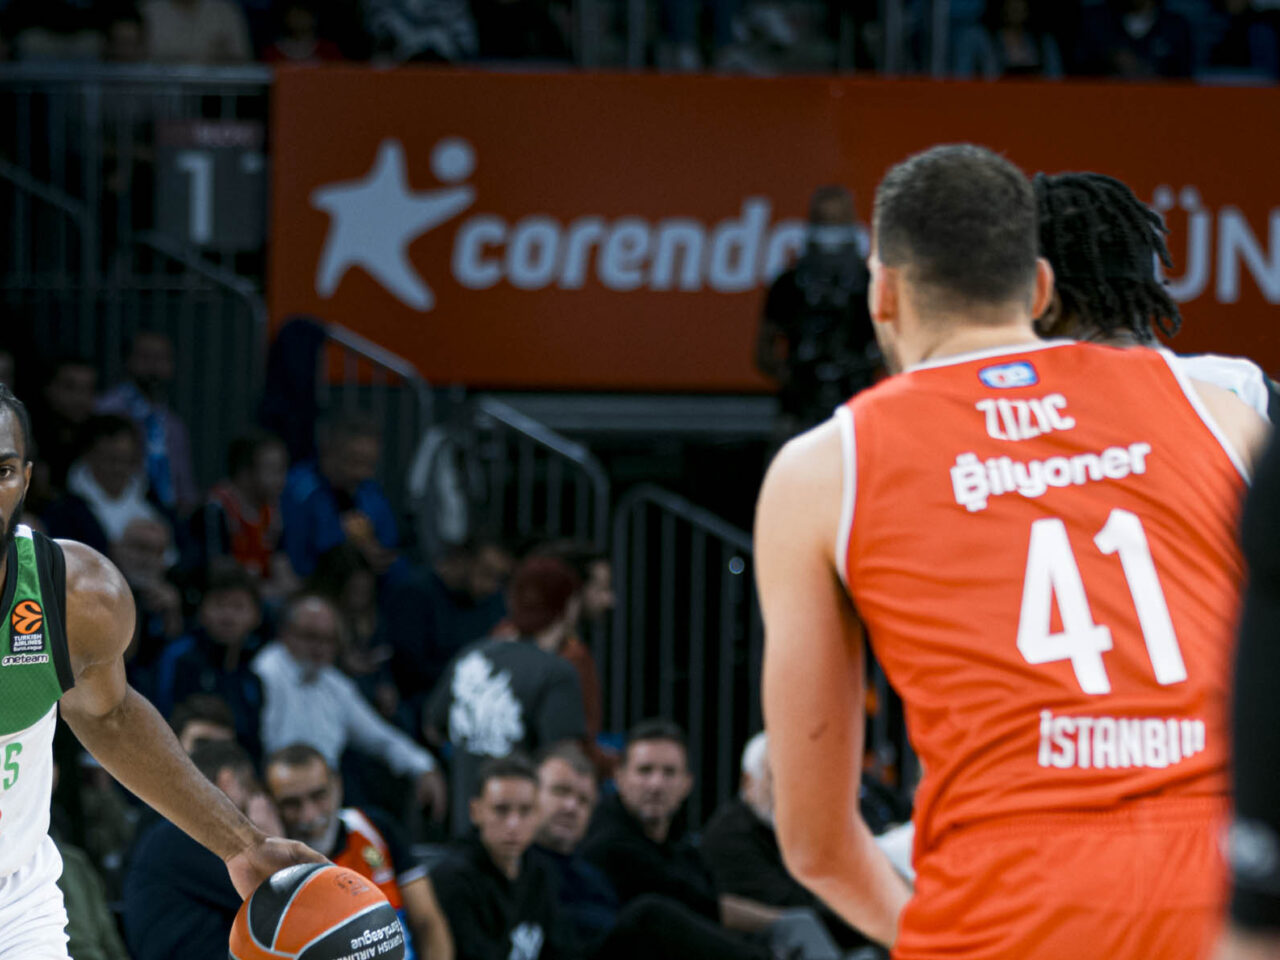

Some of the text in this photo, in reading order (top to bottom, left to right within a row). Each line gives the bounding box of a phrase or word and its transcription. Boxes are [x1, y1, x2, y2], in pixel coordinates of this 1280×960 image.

[451, 196, 869, 293] corendo
[949, 442, 1152, 512] Bilyoner
[1016, 508, 1188, 695] 41
